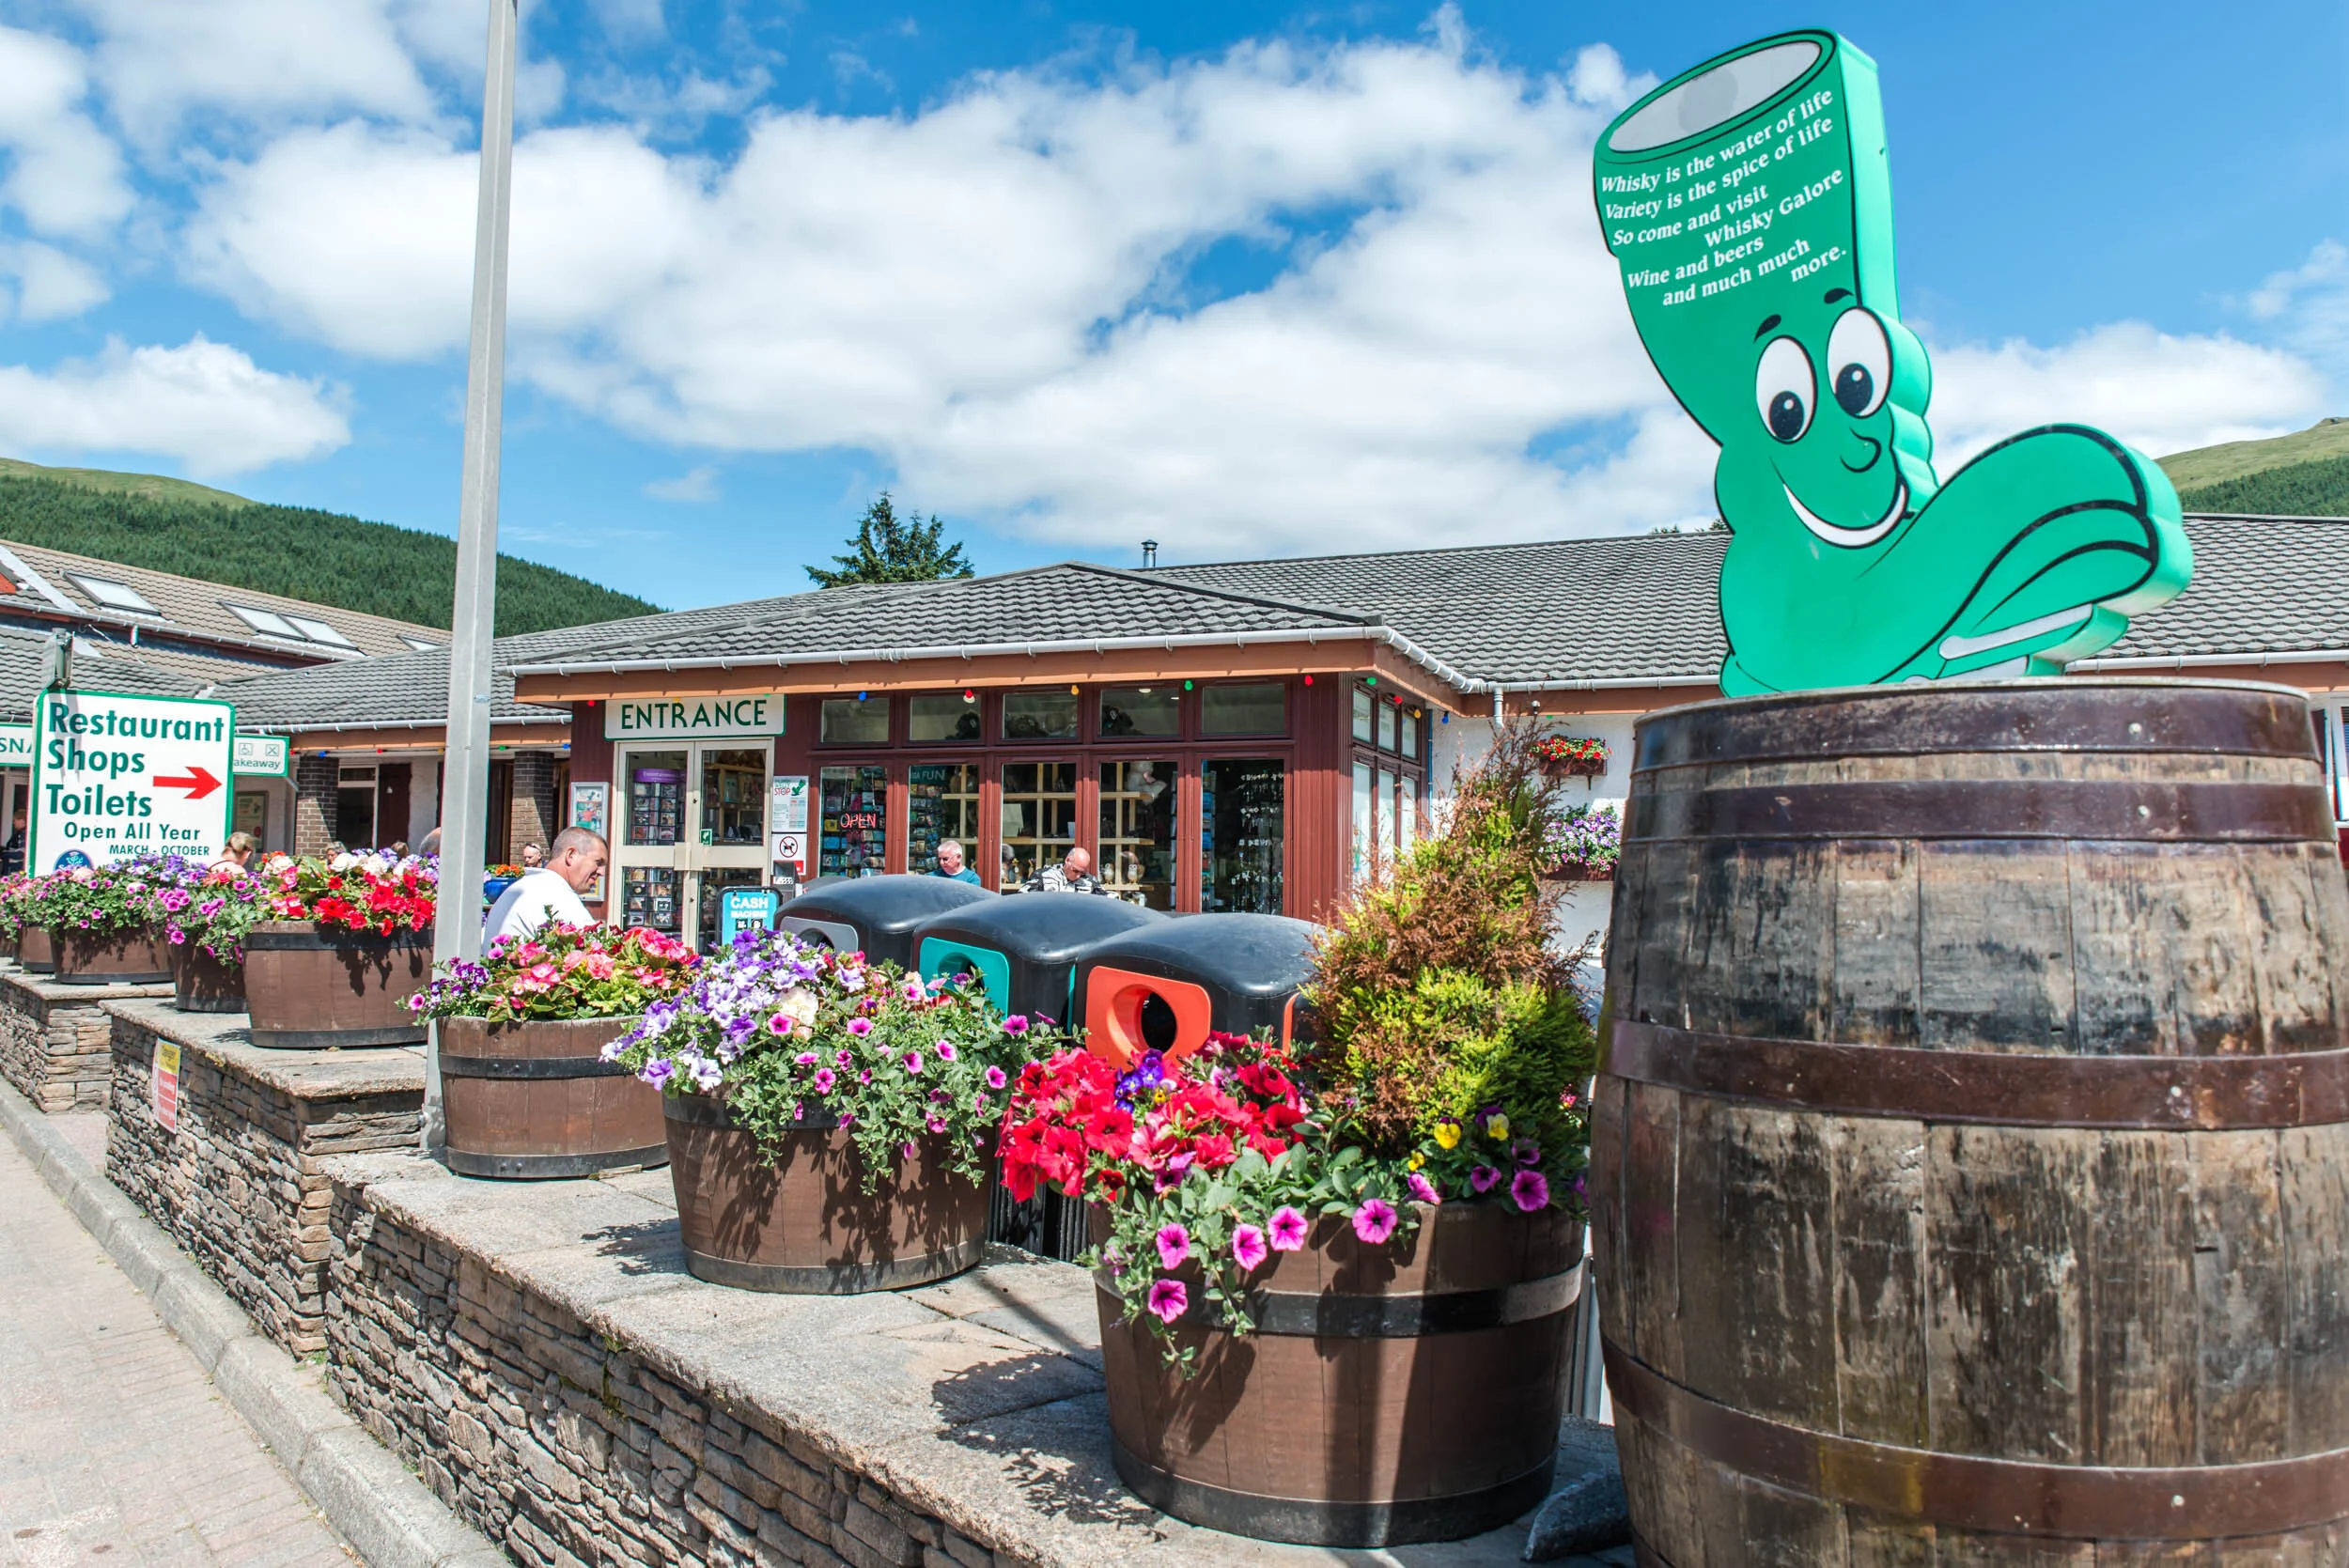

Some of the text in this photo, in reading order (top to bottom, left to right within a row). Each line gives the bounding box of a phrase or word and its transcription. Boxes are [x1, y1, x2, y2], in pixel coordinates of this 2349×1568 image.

[1601, 88, 1834, 194] Whisky is the water of life
[1606, 116, 1834, 219] Variety is the spice of life
[1612, 183, 1768, 246] So come and visit
[1704, 168, 1843, 248] Whisky Galore
[1626, 236, 1765, 288] Wine and beers
[1662, 237, 1812, 306] and much much
[1790, 248, 1847, 282] more.
[49, 703, 224, 742] Restaurant
[621, 700, 767, 729] ENTRANCE
[48, 739, 145, 780] Shops
[234, 758, 280, 768] akeaway
[922, 769, 945, 780] FUN
[46, 784, 152, 816] Toilets
[64, 822, 201, 843] Open All Year
[840, 813, 876, 829] OPEN
[109, 846, 149, 855] MARCH
[161, 846, 210, 856] OCTOBER
[731, 897, 769, 908] CASH
[731, 909, 768, 919] MACHINE
